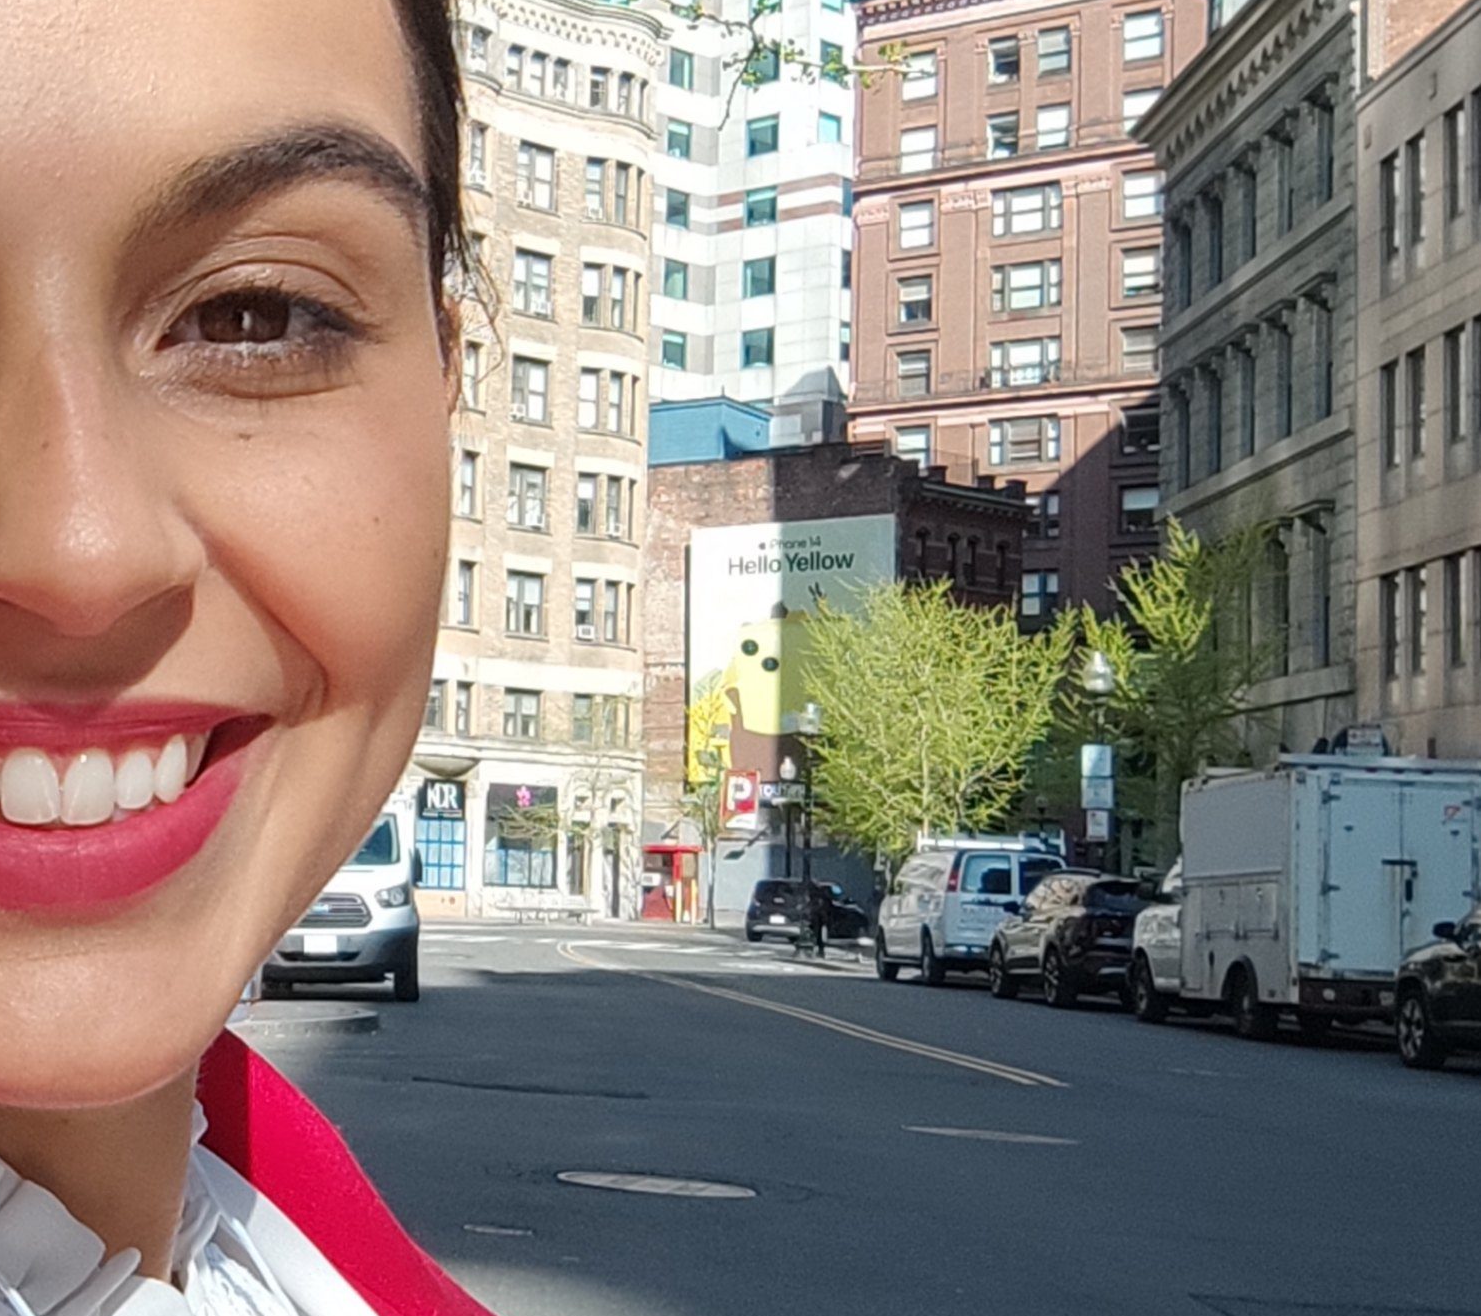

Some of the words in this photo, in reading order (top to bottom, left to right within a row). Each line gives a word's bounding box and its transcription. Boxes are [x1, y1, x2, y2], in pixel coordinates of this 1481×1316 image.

[728, 554, 782, 575] Hello
[784, 551, 855, 573] Yellow
[726, 775, 753, 812] P
